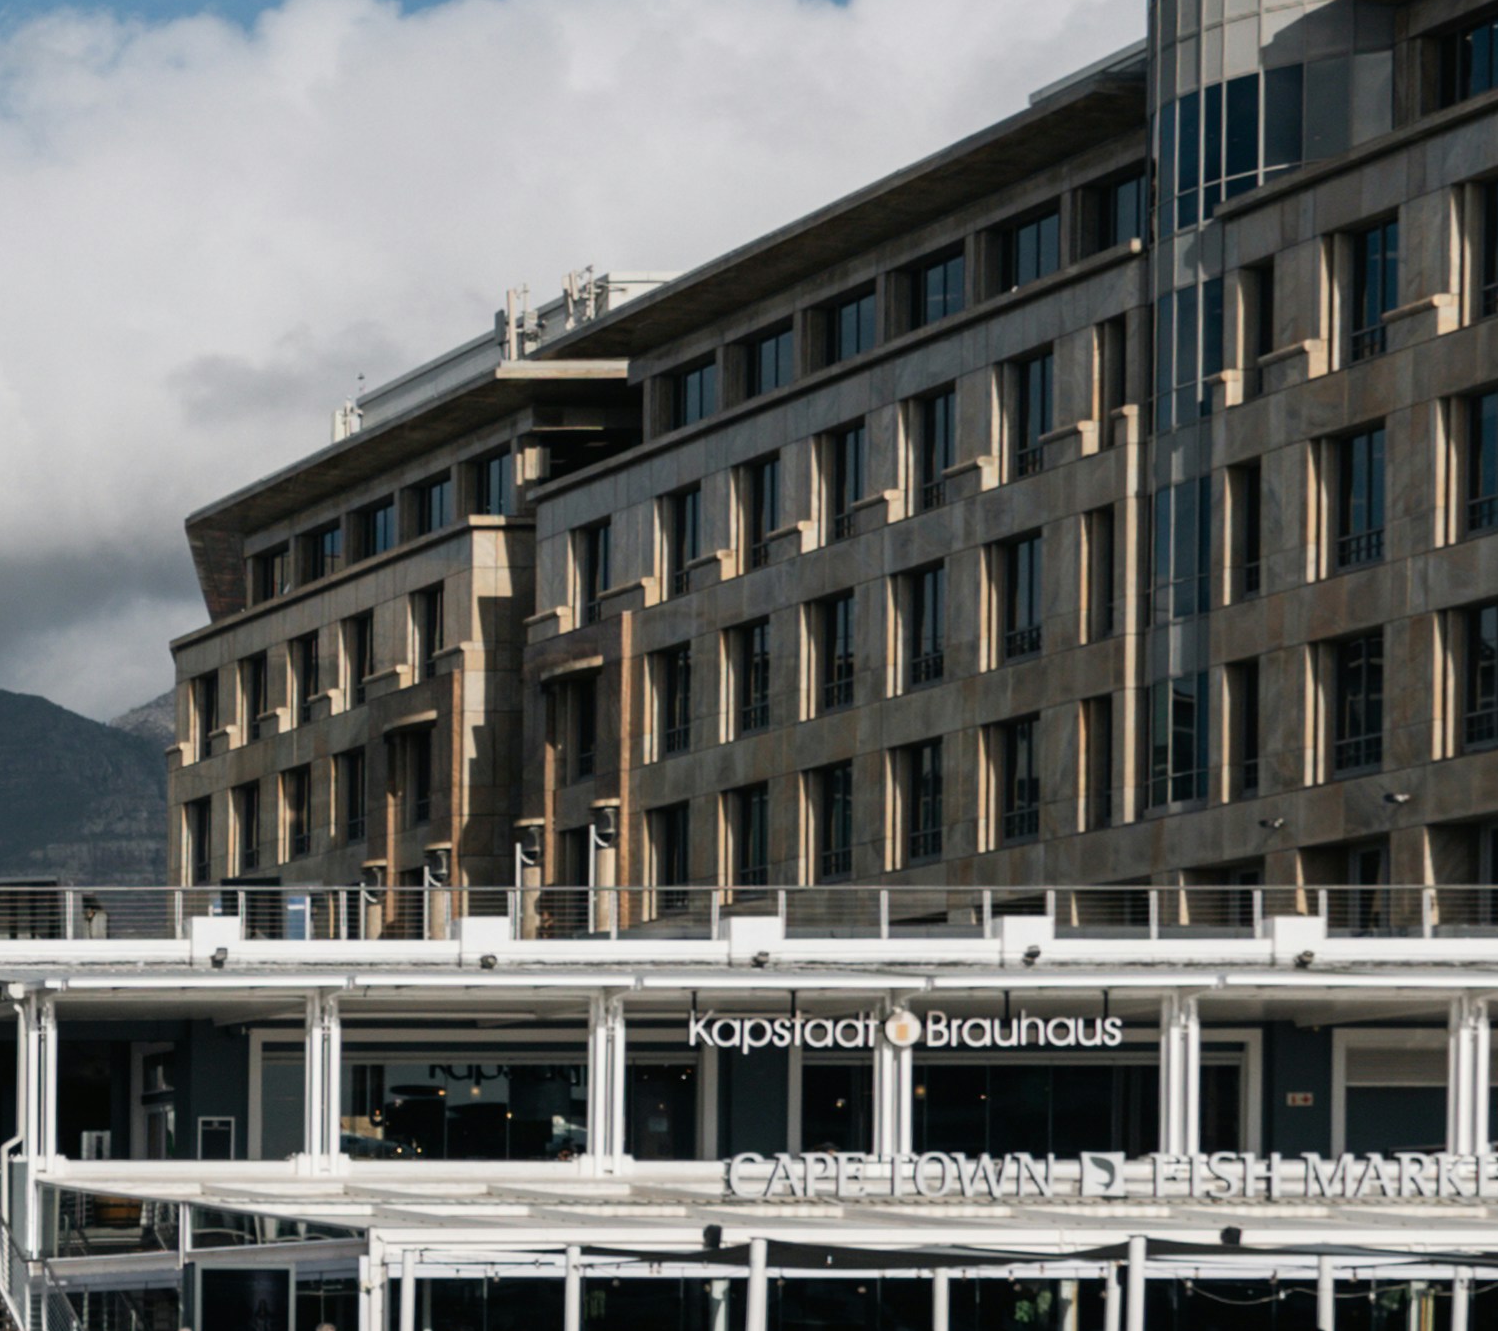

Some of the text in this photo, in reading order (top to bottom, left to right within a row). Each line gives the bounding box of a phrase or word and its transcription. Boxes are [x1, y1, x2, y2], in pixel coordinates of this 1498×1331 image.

[689, 1008, 1123, 1055] Kapstadt Brauhaus
[728, 1151, 867, 1198] CAPE
[890, 1151, 1055, 1199] TOWN
[1150, 1150, 1282, 1200] FISH
